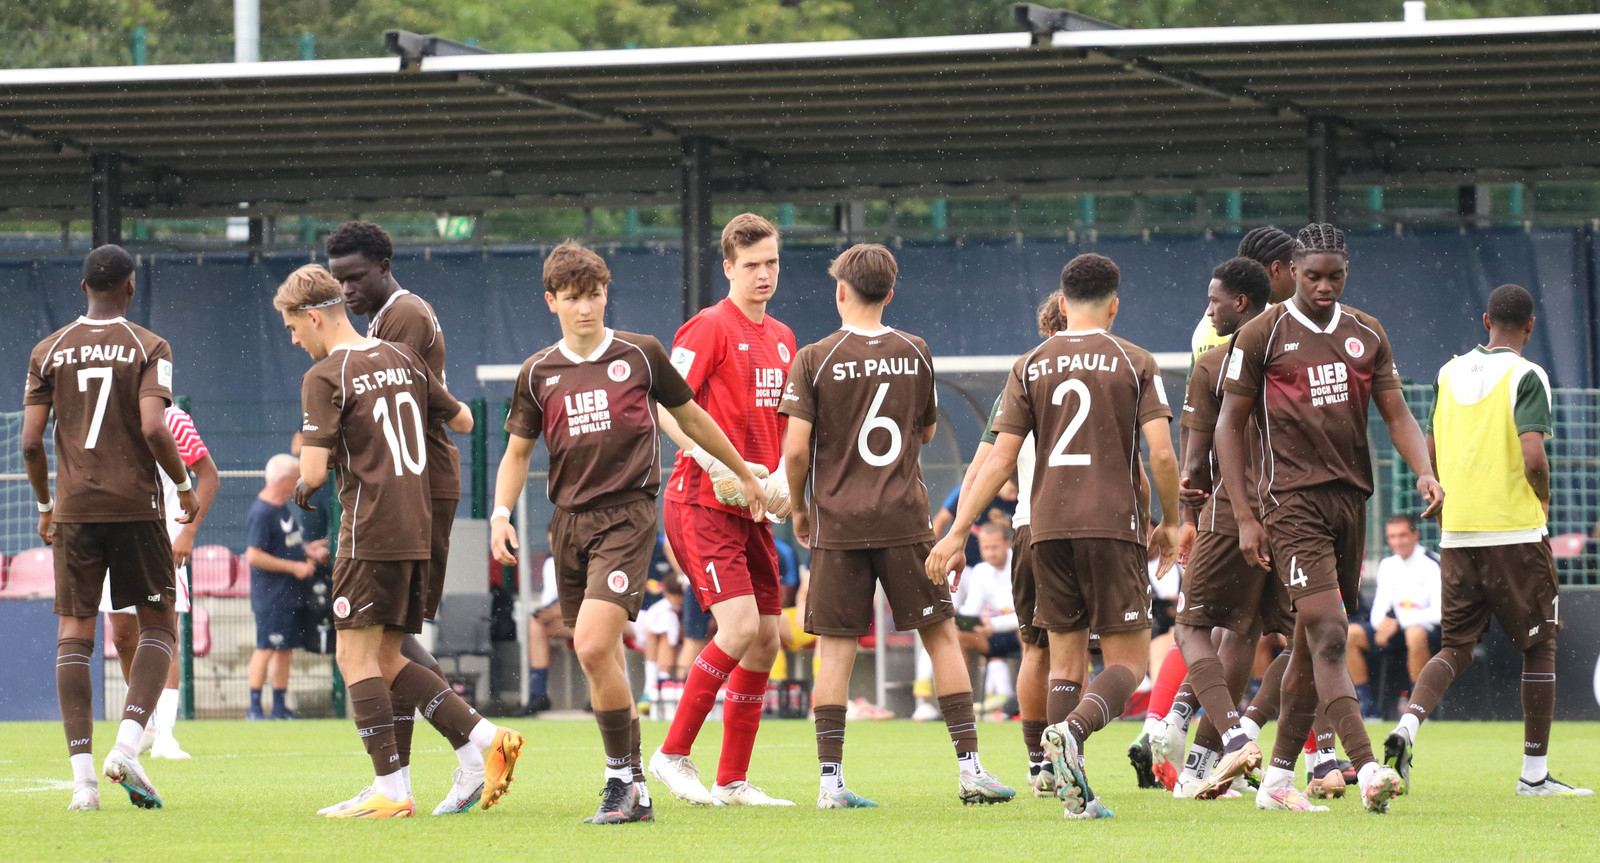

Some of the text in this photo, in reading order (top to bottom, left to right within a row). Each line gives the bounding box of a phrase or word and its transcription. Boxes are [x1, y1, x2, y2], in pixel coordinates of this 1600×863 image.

[53, 345, 136, 367] ST. PAULI
[832, 358, 919, 380] ST. PAULI
[1028, 354, 1118, 381] ST. PAULI
[755, 368, 783, 388] LIEB
[1307, 362, 1348, 387] LIEB
[564, 389, 609, 416] LIEB
[1311, 383, 1348, 397] DOCH WEN
[1312, 393, 1349, 407] DU WILLST
[77, 367, 113, 450] 7
[568, 410, 611, 427] DOCH WEN
[373, 391, 427, 476] 10
[569, 420, 612, 437] DU WILLST
[858, 383, 902, 467] 6
[1049, 378, 1091, 467] 2
[705, 561, 721, 594] 1
[1290, 555, 1308, 588] 4
